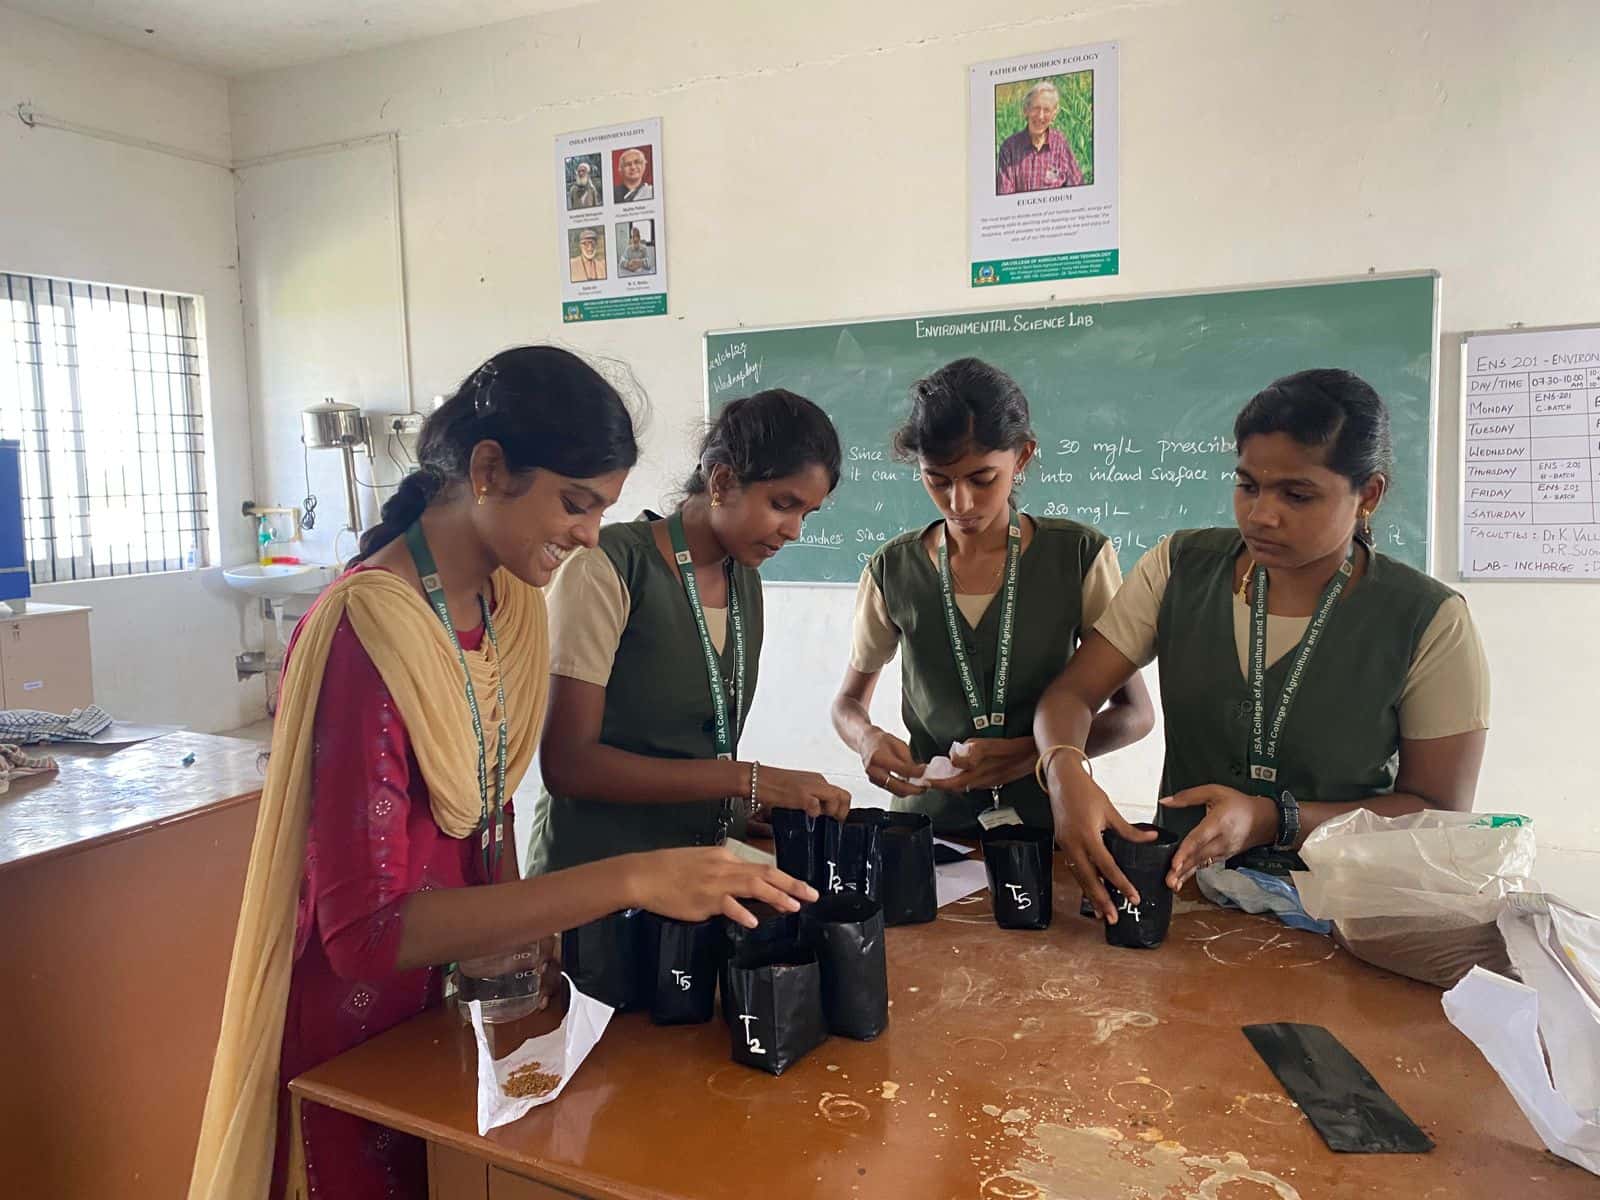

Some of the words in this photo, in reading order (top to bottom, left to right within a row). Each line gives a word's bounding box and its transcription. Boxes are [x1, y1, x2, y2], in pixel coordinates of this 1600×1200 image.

[989, 64, 1017, 77] FATHER
[1018, 64, 1028, 72] OF
[1029, 60, 1061, 70] MODERN
[1062, 53, 1099, 65] ECOLOGY
[1017, 198, 1046, 207] EUGENE
[1048, 195, 1073, 203] ODUM
[1511, 356, 1537, 369] 201
[848, 446, 882, 461] Since
[1093, 436, 1142, 465] mg/L
[850, 465, 860, 481] it
[872, 471, 897, 481] can
[1040, 466, 1073, 483] into
[1089, 465, 1142, 482] inland
[1007, 544, 1019, 586] Technology
[1514, 560, 1575, 573] INCHARGE
[1256, 570, 1266, 619] Technology
[1313, 581, 1344, 627] Technology
[1001, 598, 1014, 646] Agriculture
[1256, 620, 1264, 636] and
[1308, 628, 1319, 645] and
[955, 651, 965, 662] of
[1000, 647, 1010, 659] of
[1253, 638, 1264, 687] Agriculture
[958, 662, 972, 692] College
[997, 659, 1008, 689] College
[1287, 646, 1312, 695] Agriculture
[967, 692, 980, 708] JSA
[996, 688, 1006, 705] JSA
[1254, 687, 1262, 699] of
[1283, 694, 1292, 705] of
[715, 694, 724, 727] College
[1253, 698, 1263, 735] College
[1270, 704, 1287, 740] College
[718, 727, 726, 745] JSA
[1253, 736, 1263, 756] JSA
[1266, 740, 1278, 759] JSA
[1005, 883, 1032, 910] T5
[738, 1014, 767, 1054] T2
